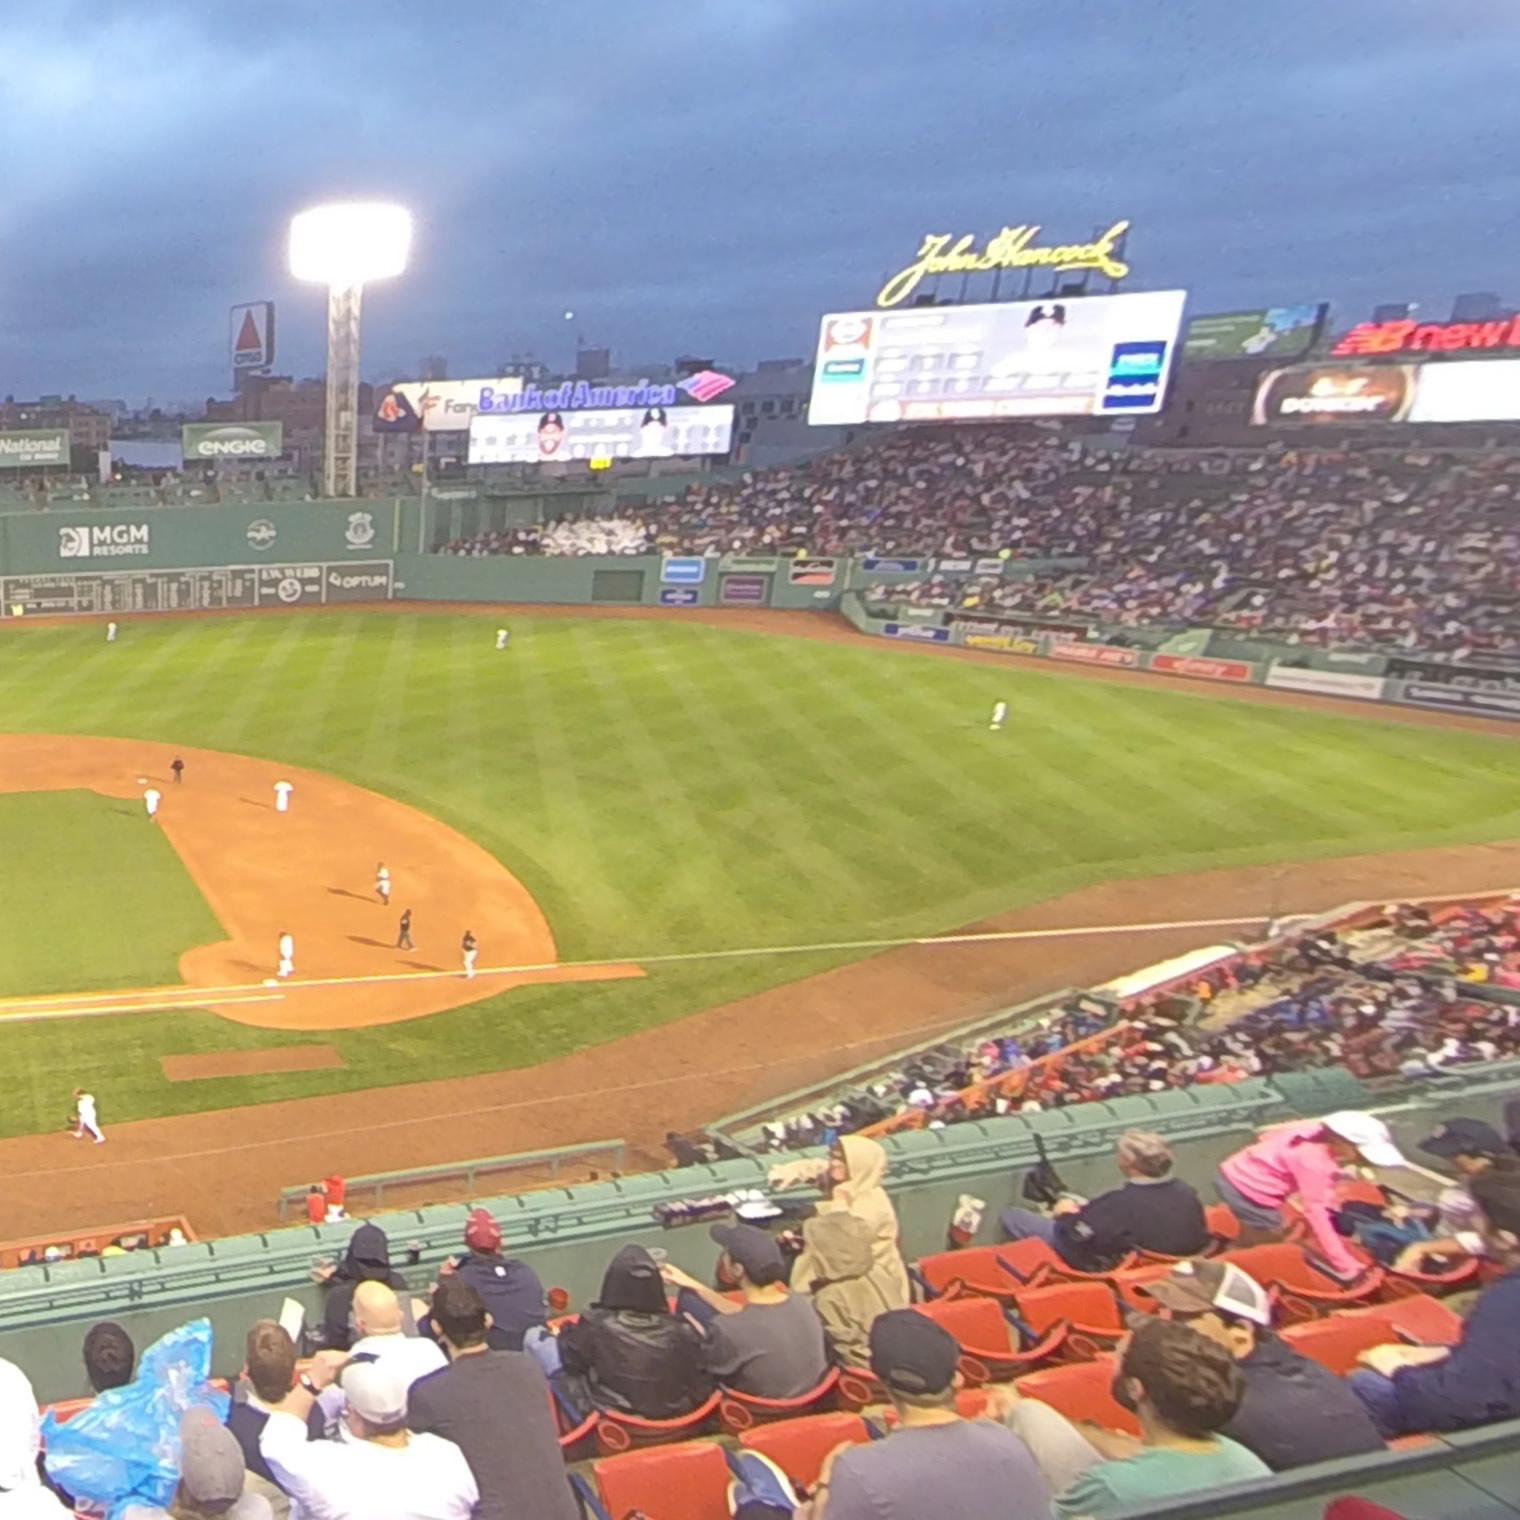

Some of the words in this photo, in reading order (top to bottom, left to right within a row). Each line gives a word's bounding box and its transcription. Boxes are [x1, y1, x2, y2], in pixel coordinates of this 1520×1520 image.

[877, 233, 983, 307] John
[981, 219, 1129, 279] Hancock
[479, 382, 543, 412] Bank
[541, 381, 572, 410] of
[573, 378, 677, 407] America
[92, 523, 149, 545] MGM
[93, 544, 149, 557] RESORTS
[343, 575, 388, 589] OPTUM
